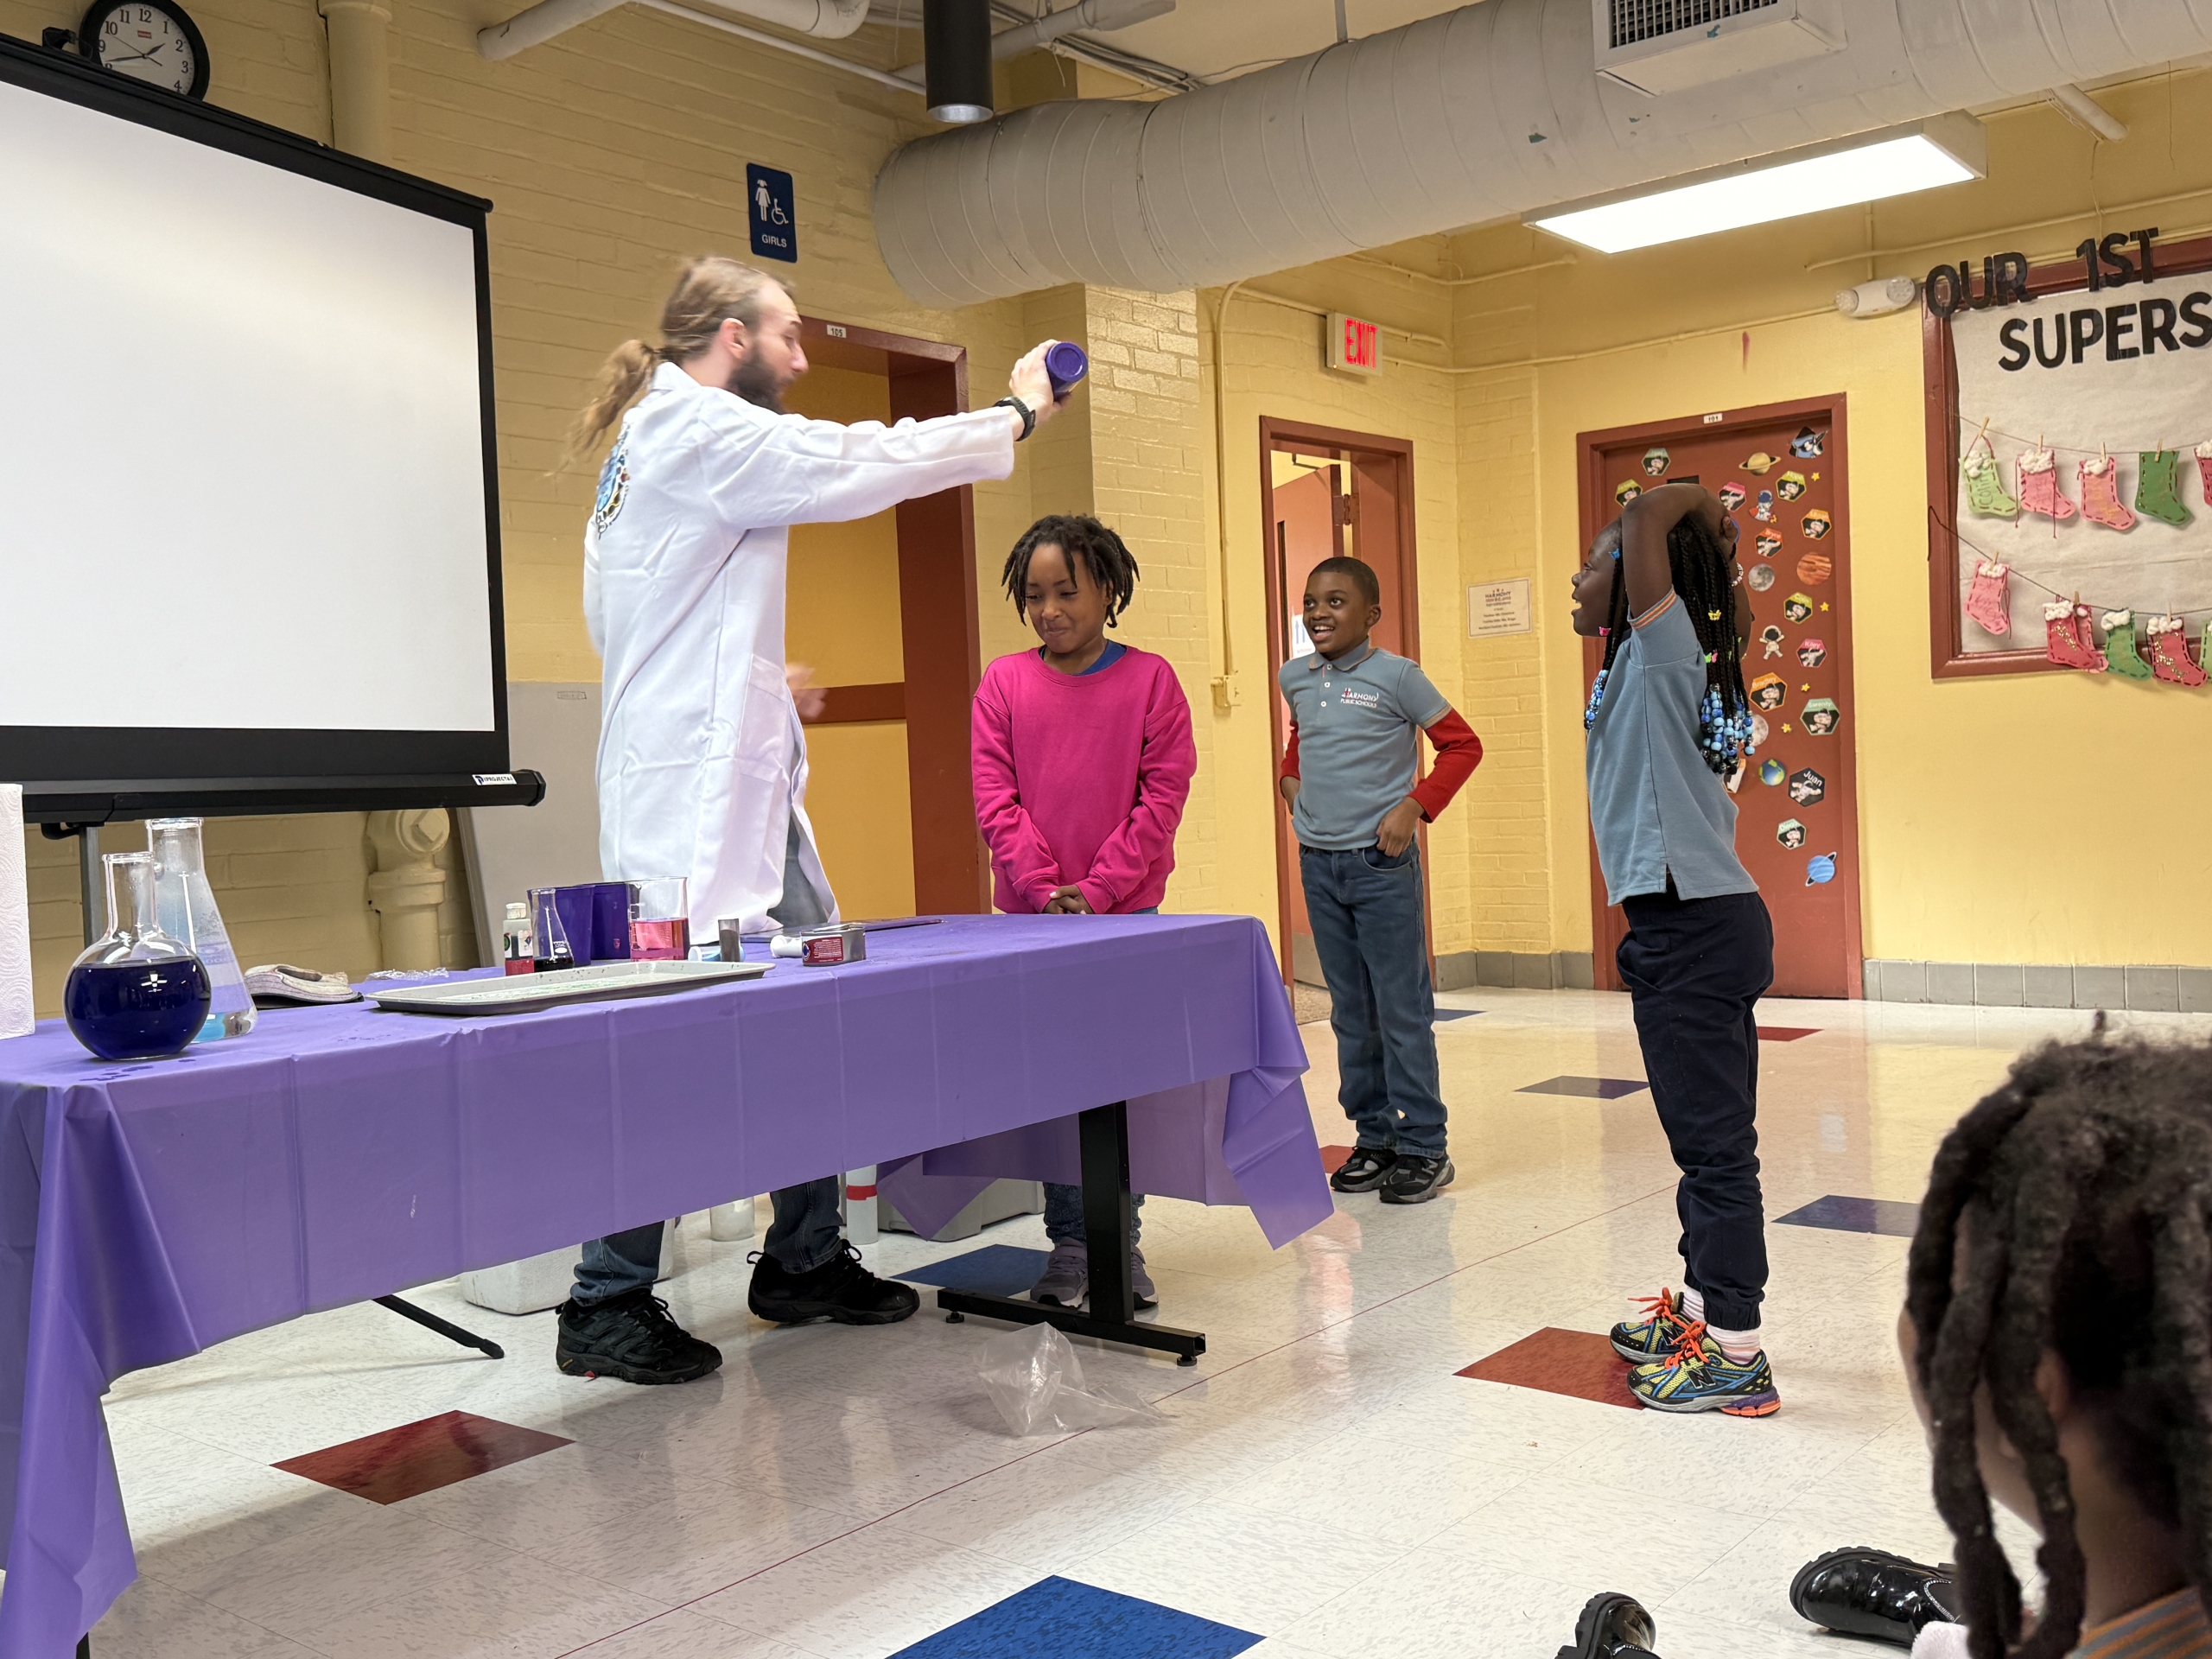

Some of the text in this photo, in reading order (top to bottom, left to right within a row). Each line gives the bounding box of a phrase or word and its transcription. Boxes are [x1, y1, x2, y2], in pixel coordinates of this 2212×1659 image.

[119, 9, 130, 24] 11
[139, 8, 152, 23] 12
[105, 21, 118, 35] 10
[163, 21, 168, 35] 1
[99, 39, 105, 53] 9
[175, 39, 183, 52] 2
[181, 60, 188, 73] 3
[174, 80, 182, 92] 4
[761, 234, 787, 248] GIRLS
[1925, 226, 2158, 318] OUR 1ST
[831, 327, 843, 337] 105
[1999, 291, 2212, 372] SUPERS
[1345, 317, 1378, 370] EXIT
[1341, 689, 1379, 702] HARMONY
[1802, 770, 1824, 787] Juan
[1686, 1367, 1716, 1389] N
